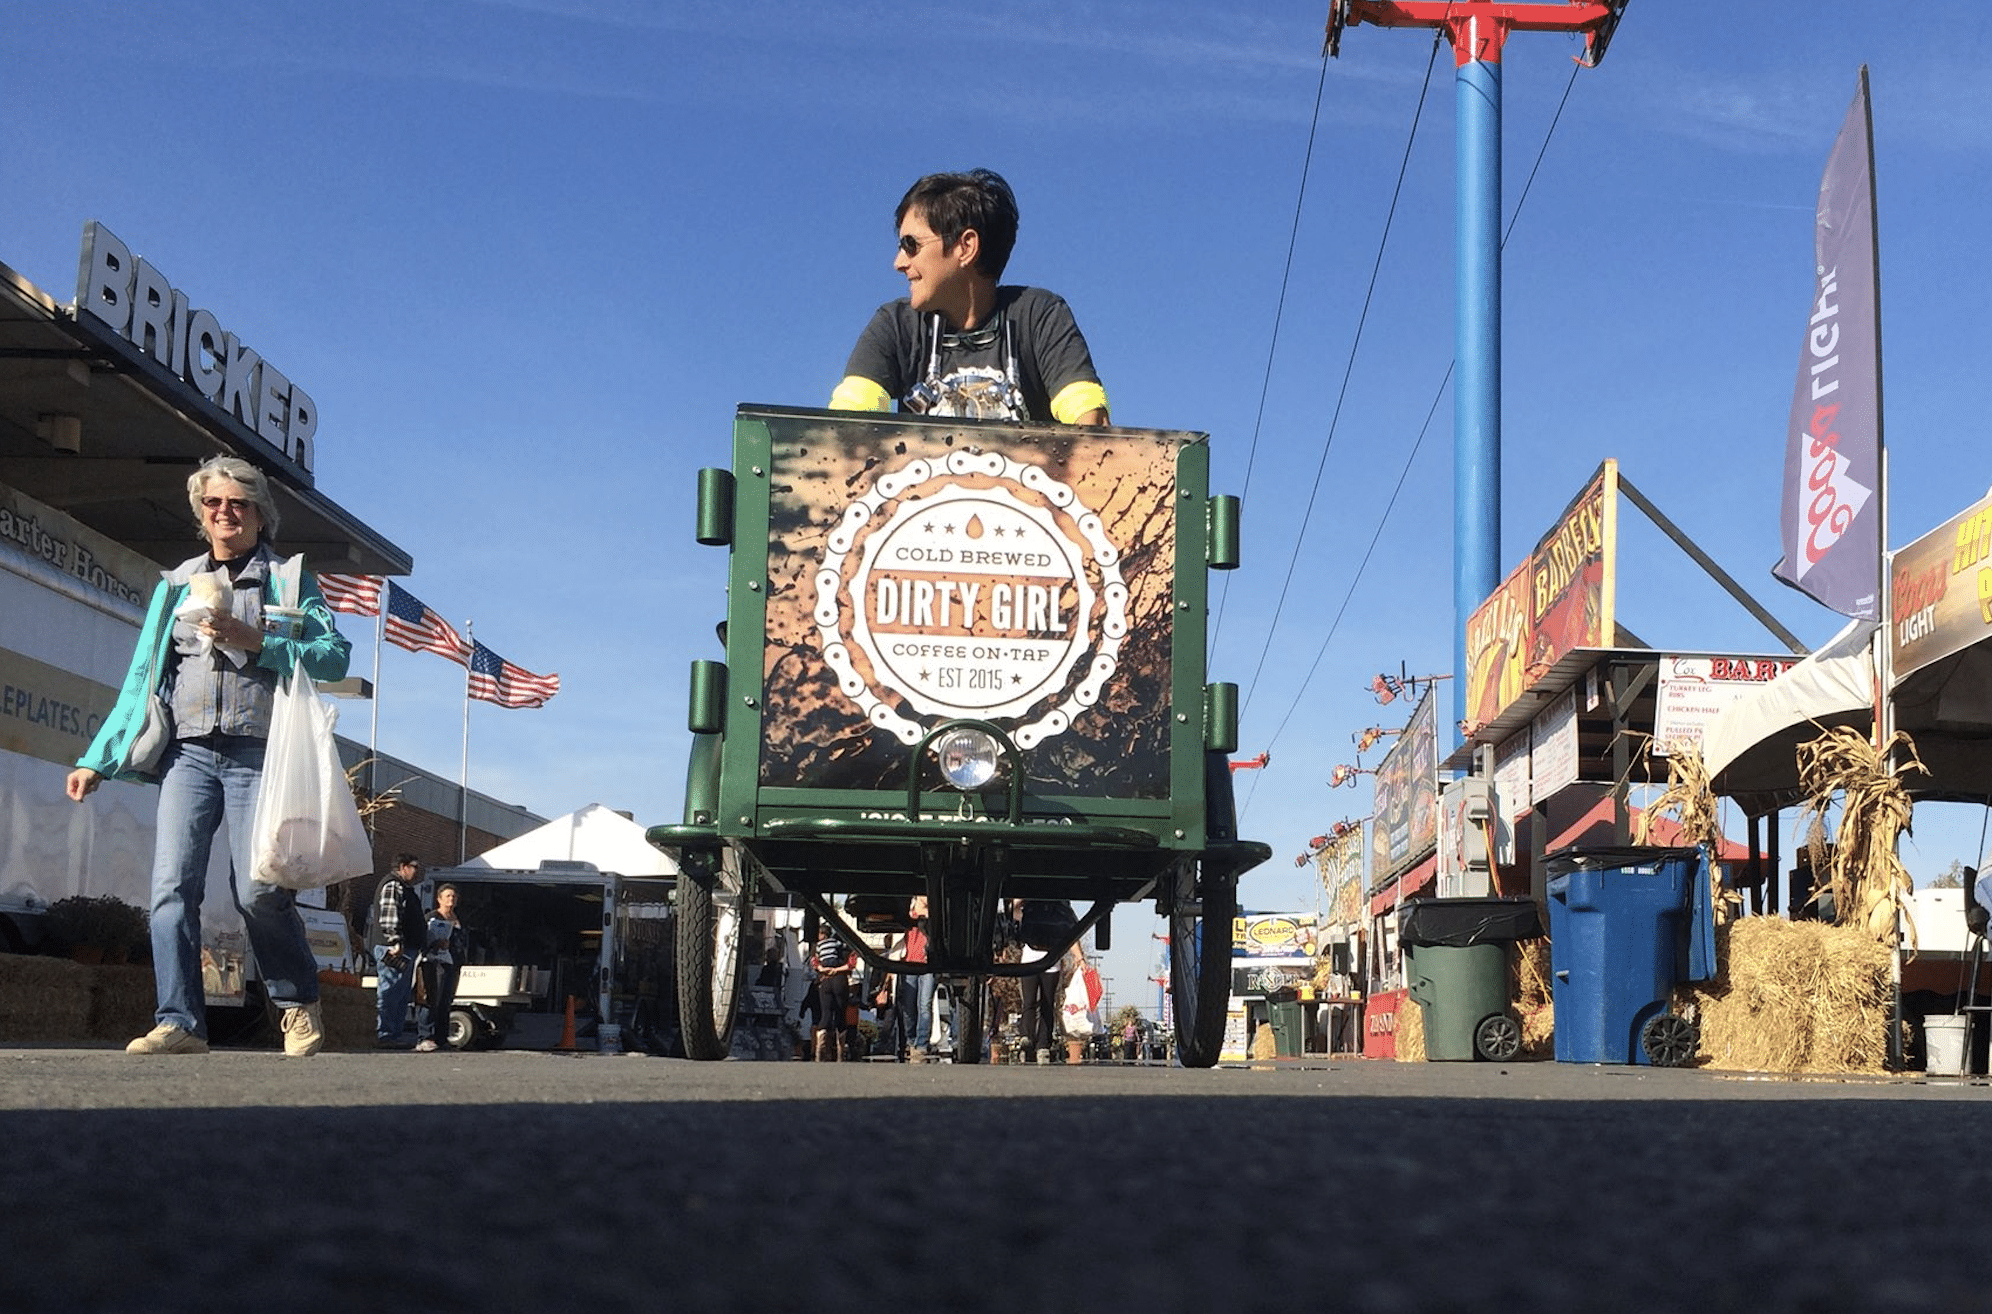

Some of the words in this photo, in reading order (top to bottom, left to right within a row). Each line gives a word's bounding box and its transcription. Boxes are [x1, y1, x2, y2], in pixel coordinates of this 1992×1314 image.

[82, 220, 317, 474] BRICKER
[895, 547, 954, 563] COLD
[960, 550, 1052, 567] BREWED
[875, 577, 981, 629] DIRTY
[991, 583, 1068, 632] GIRL
[1900, 603, 1936, 648] LIGHT
[892, 643, 967, 659] COFFEE
[938, 667, 964, 689] EST
[969, 668, 1003, 691] 2015
[1673, 659, 1697, 675] Cox
[0, 684, 100, 741] EPLATES.C
[1253, 926, 1295, 936] LEONARD
